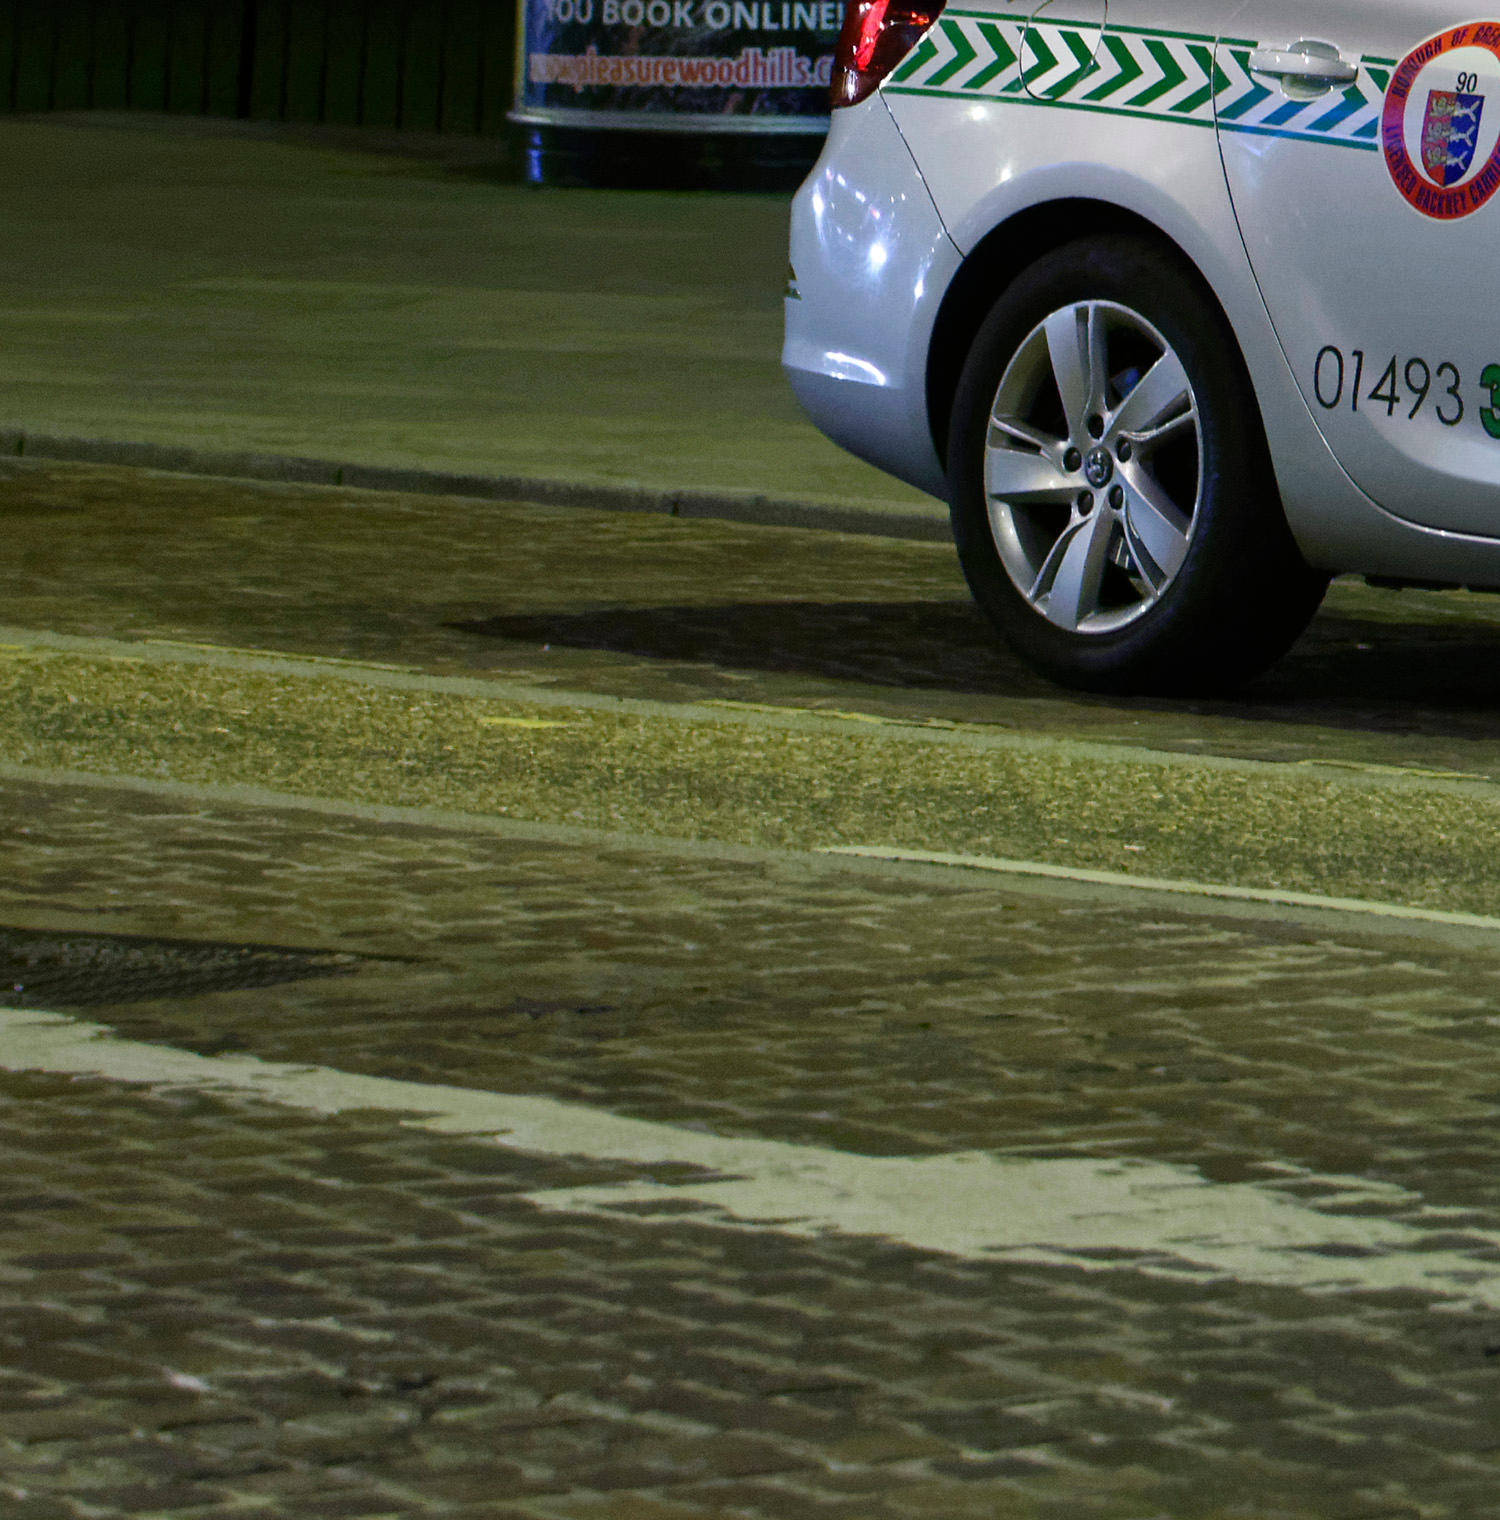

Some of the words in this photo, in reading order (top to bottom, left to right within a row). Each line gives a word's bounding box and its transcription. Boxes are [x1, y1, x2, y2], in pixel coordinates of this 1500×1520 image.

[602, 0, 694, 29] BOOK
[1391, 37, 1443, 99] BOROUGH
[1450, 28, 1469, 48] OF
[1455, 71, 1479, 94] 90
[1313, 344, 1466, 427] 01493
